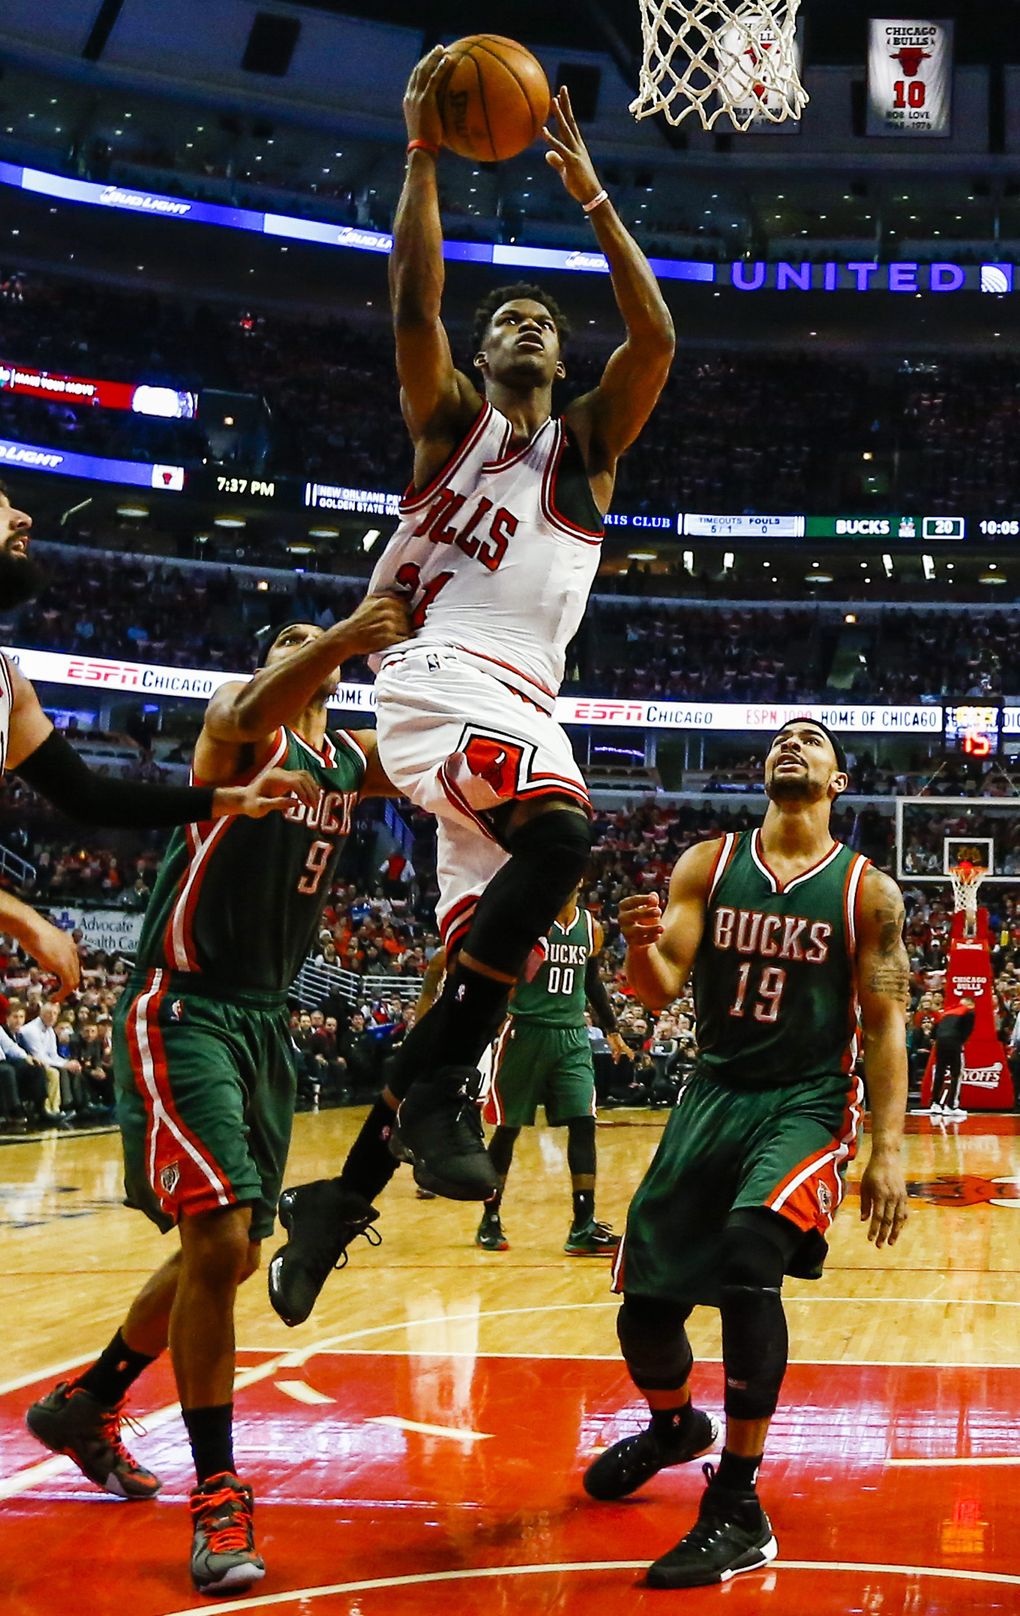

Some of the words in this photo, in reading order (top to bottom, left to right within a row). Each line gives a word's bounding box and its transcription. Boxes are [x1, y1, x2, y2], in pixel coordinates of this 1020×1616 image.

[885, 27, 936, 36] CHICAGO
[893, 37, 929, 46] BULLS
[893, 81, 925, 108] 10
[908, 111, 930, 119] LOVE
[142, 197, 191, 215] LIGHT
[731, 262, 965, 291] UNITED
[7, 446, 64, 468] LIGHT
[217, 476, 248, 493] 7:37
[250, 481, 275, 497] PM
[319, 486, 340, 497] NEW
[343, 489, 386, 503] ORLEANS
[319, 498, 356, 512] GOLDEN
[357, 502, 384, 515] STATE
[604, 514, 628, 525] RIS
[632, 516, 671, 528] CLUB
[700, 517, 743, 525] TIMEOUTS
[835, 520, 890, 534] BUCKS
[935, 520, 953, 534] 20
[979, 520, 1019, 535] 10:05
[761, 526, 768, 534] 0
[67, 661, 139, 685] ESPN
[142, 670, 213, 694] CHICAGO
[575, 703, 643, 721] ESPN
[646, 706, 713, 724] CHICAGO
[746, 709, 778, 724] ESPN
[821, 711, 855, 726] HOME
[862, 711, 876, 726] OF
[882, 711, 937, 727] CHICAGO
[297, 840, 335, 894] 9
[80, 917, 134, 932] Advocate
[714, 906, 832, 965] BUCKS
[547, 966, 575, 995] 00
[952, 976, 987, 984] CHICAGO
[956, 983, 982, 991] BULLS
[729, 962, 786, 1022] 19
